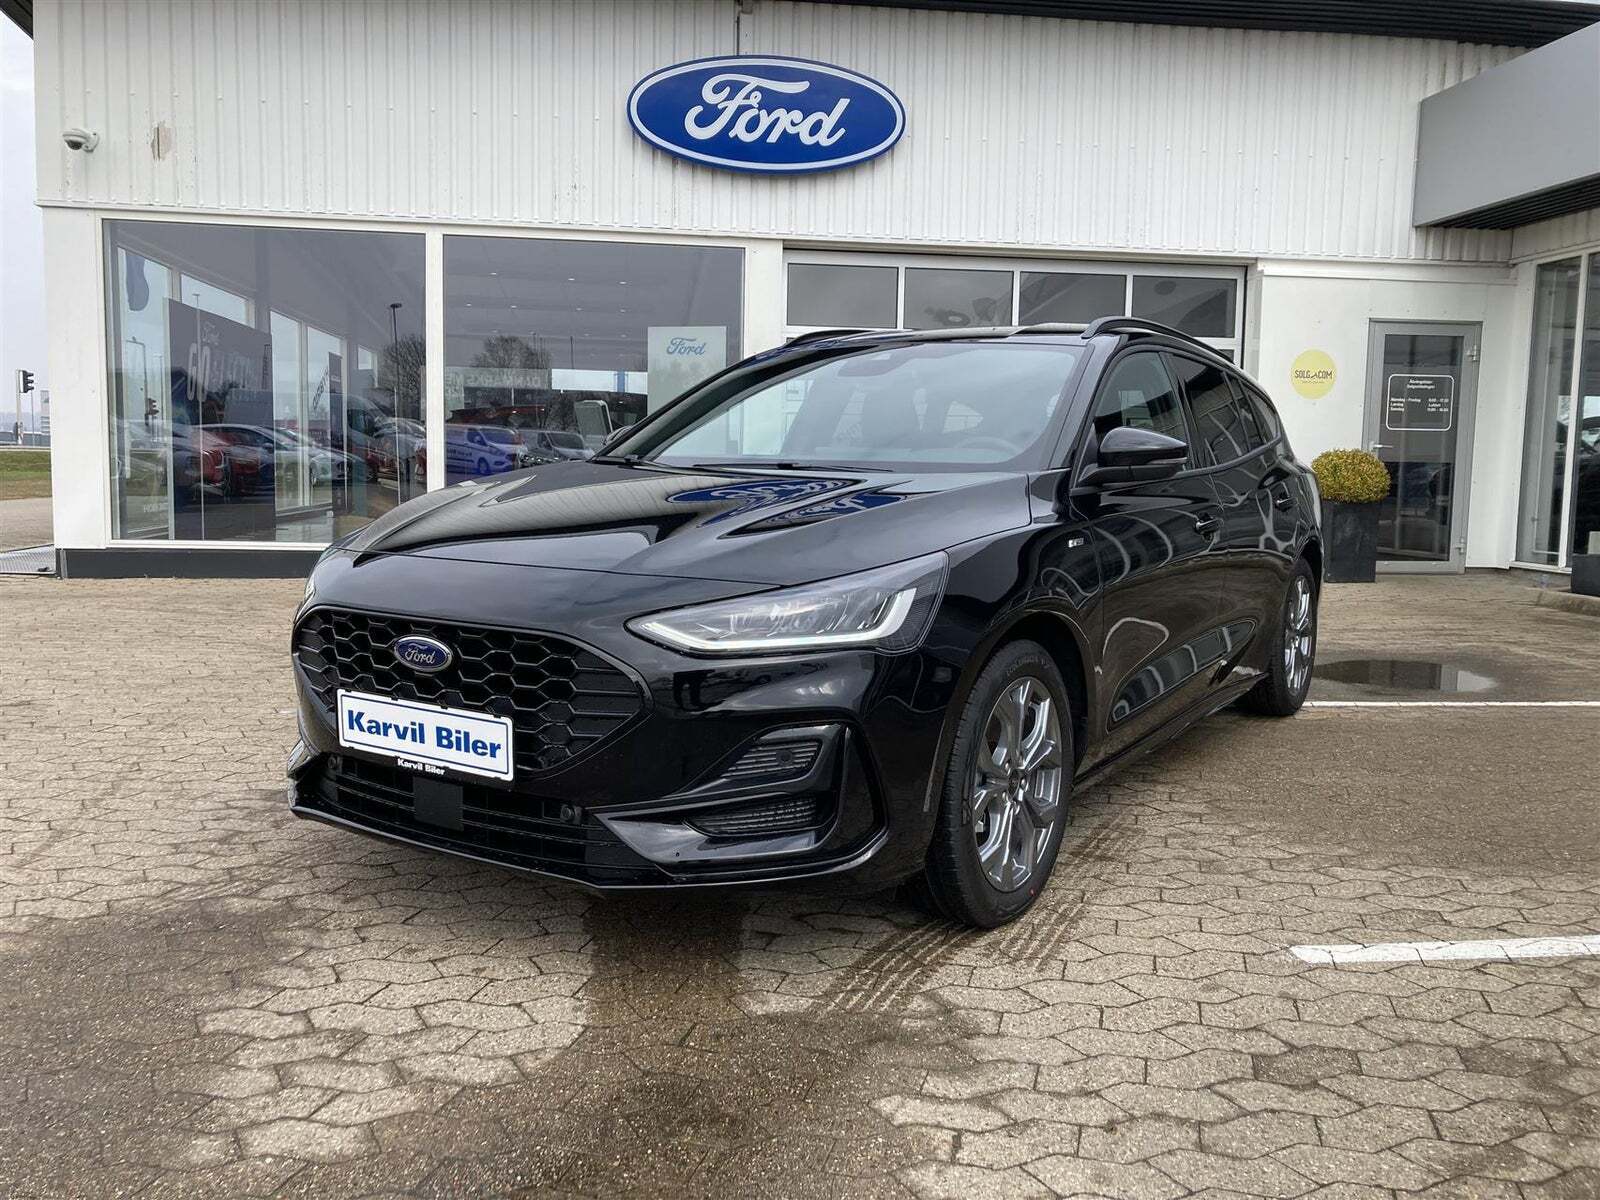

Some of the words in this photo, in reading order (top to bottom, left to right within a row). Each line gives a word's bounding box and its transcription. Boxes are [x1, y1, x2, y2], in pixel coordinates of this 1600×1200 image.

[684, 73, 851, 147] Ford
[666, 337, 707, 355] Ford
[404, 642, 436, 664] Ford
[347, 709, 426, 744] Karvil
[435, 726, 502, 758] Biler
[397, 758, 423, 771] Karvil
[425, 764, 446, 776] Biler
